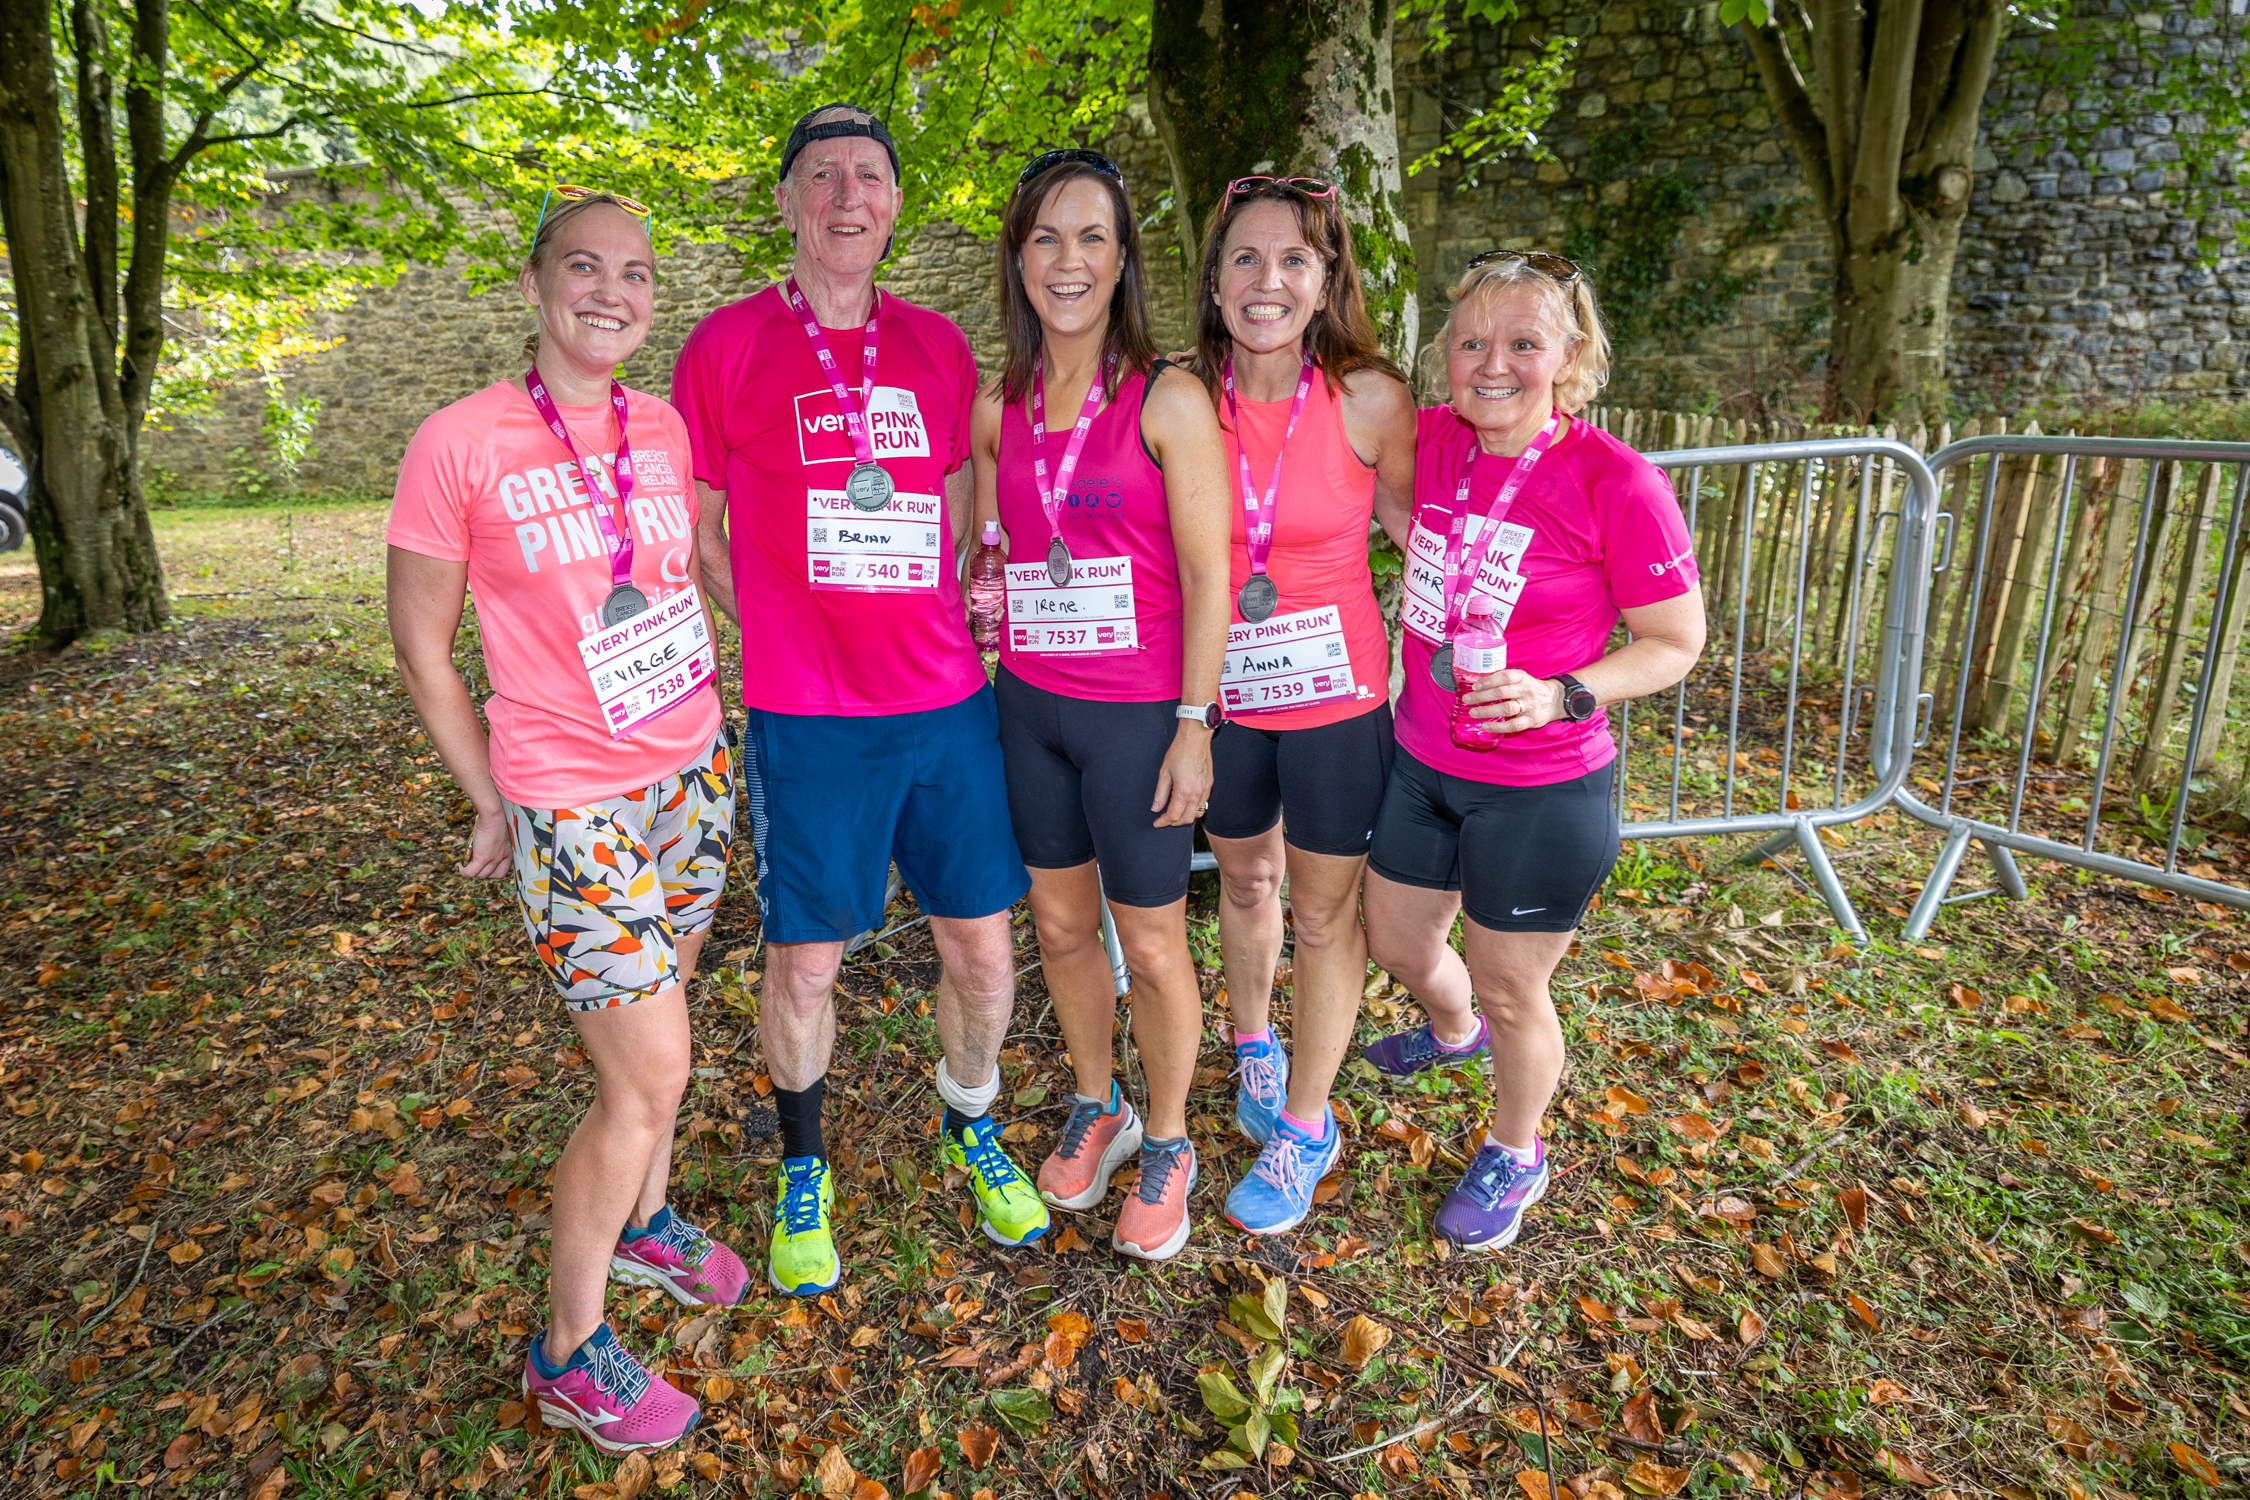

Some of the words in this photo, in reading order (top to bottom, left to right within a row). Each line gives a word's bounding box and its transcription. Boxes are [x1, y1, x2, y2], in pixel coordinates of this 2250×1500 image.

[804, 414, 851, 437] ver
[871, 412, 921, 429] PINK
[874, 431, 919, 450] RUN
[635, 463, 675, 475] CANCER
[498, 453, 618, 521] GREA
[639, 475, 678, 486] IRELAND
[1071, 475, 1122, 489] Adele's
[819, 497, 856, 511] VER
[907, 501, 933, 514] RUN
[838, 530, 891, 544] BRIAN
[855, 563, 899, 579] 7540
[1413, 531, 1443, 556] VERY
[1476, 568, 1512, 593] RUN
[1013, 570, 1047, 582] VERY
[1088, 565, 1121, 578] RUN
[590, 629, 630, 655] VERY
[633, 611, 667, 637] PINK
[668, 595, 694, 619] RUN
[1227, 629, 1251, 643] ERY
[1256, 622, 1292, 639] PINK
[1295, 614, 1330, 631] RUN
[1409, 605, 1446, 634] 7529
[1047, 630, 1086, 644] 7537
[614, 642, 678, 681] VIRGE
[1242, 655, 1292, 674] ANNA
[646, 673, 685, 704] 7538
[1260, 682, 1304, 700] 7539
[1314, 680, 1330, 688] very
[610, 708, 625, 719] very
[627, 700, 640, 710] PINK
[629, 707, 641, 715] RUN
